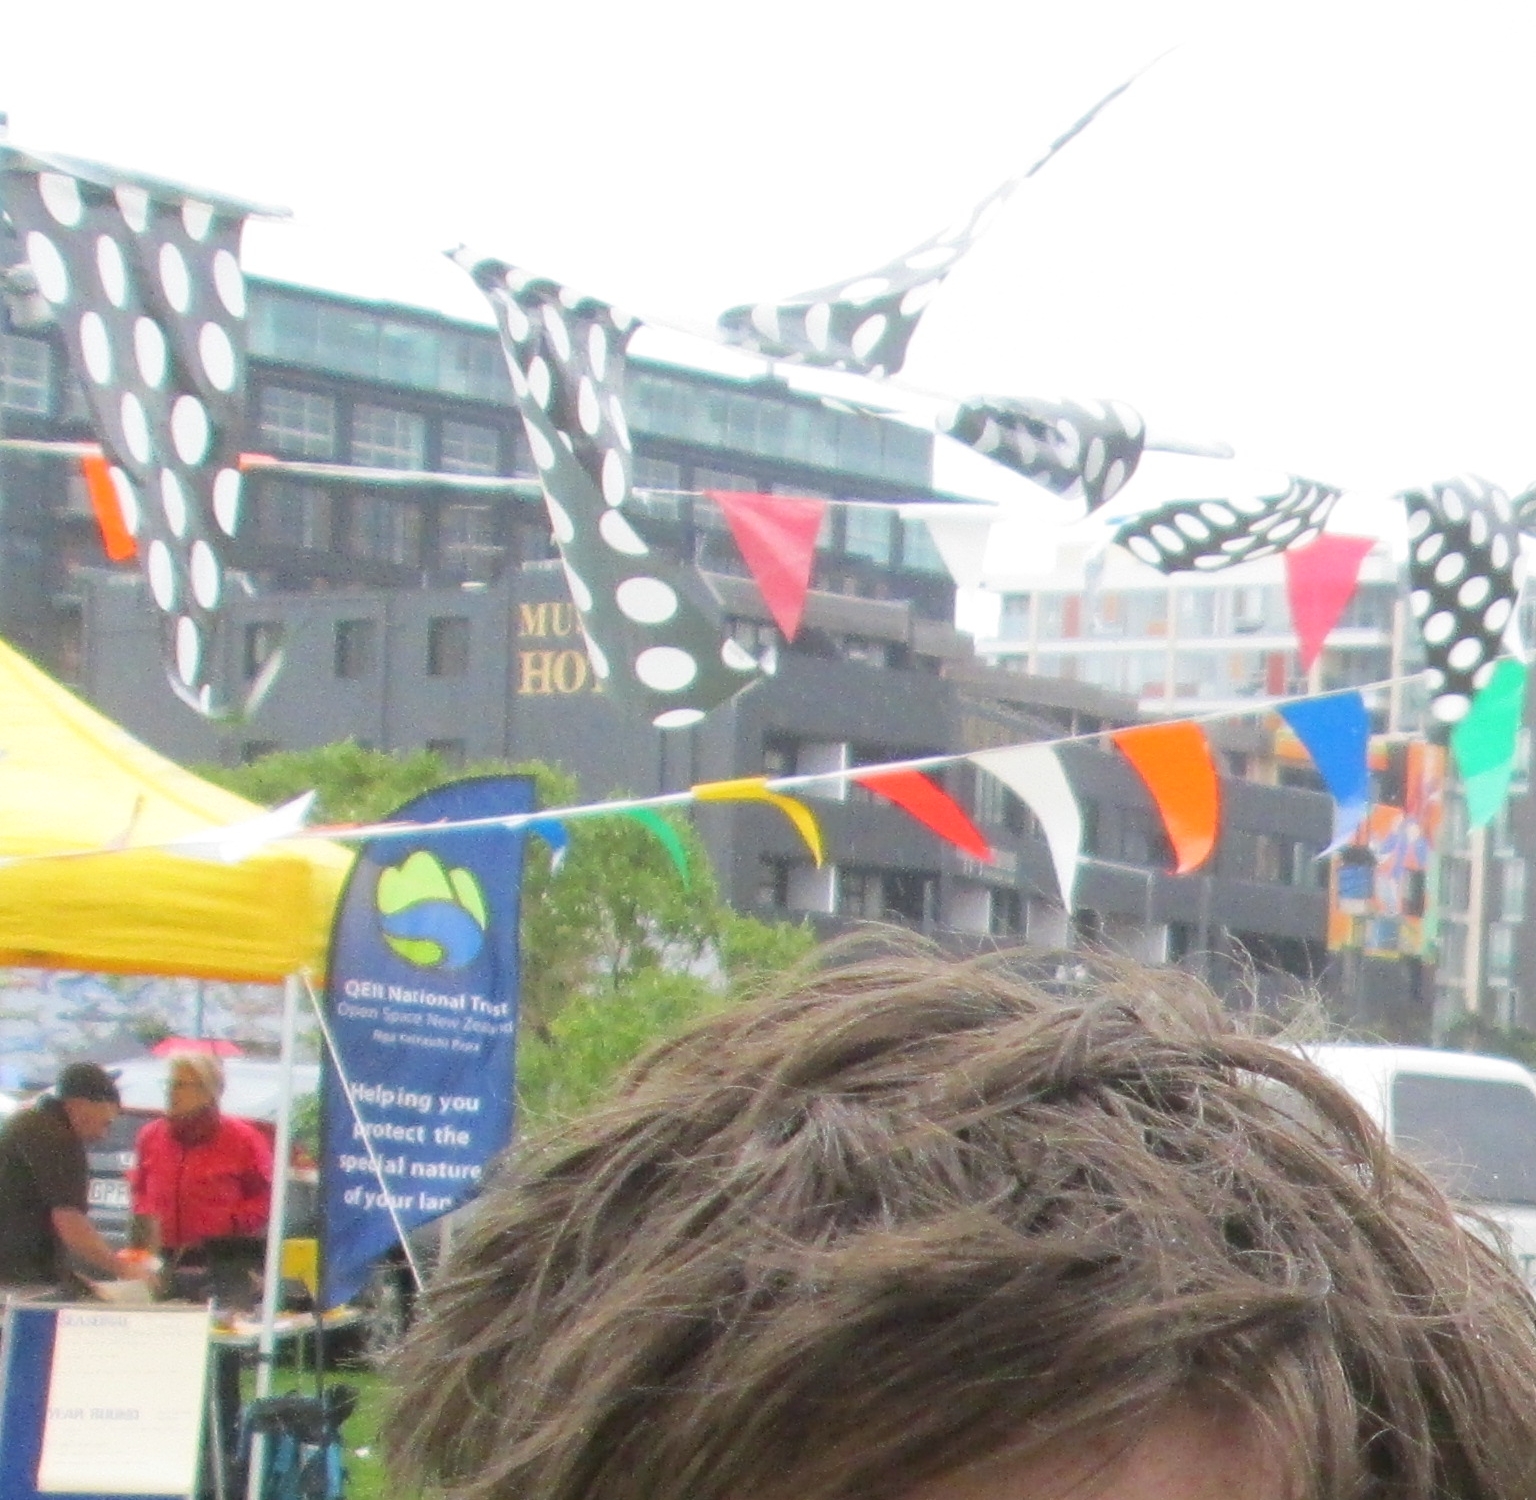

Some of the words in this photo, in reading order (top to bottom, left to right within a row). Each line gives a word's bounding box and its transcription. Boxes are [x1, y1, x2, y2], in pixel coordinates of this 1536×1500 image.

[518, 650, 604, 694] HO
[388, 985, 465, 1009] National
[470, 995, 509, 1017] Trust
[350, 1082, 433, 1113] Helping
[439, 1095, 480, 1113] you
[353, 1122, 426, 1144] protect
[434, 1125, 470, 1146] the
[339, 1154, 405, 1174] special
[410, 1161, 482, 1179] nature
[344, 1185, 363, 1205] of
[364, 1191, 414, 1210] your
